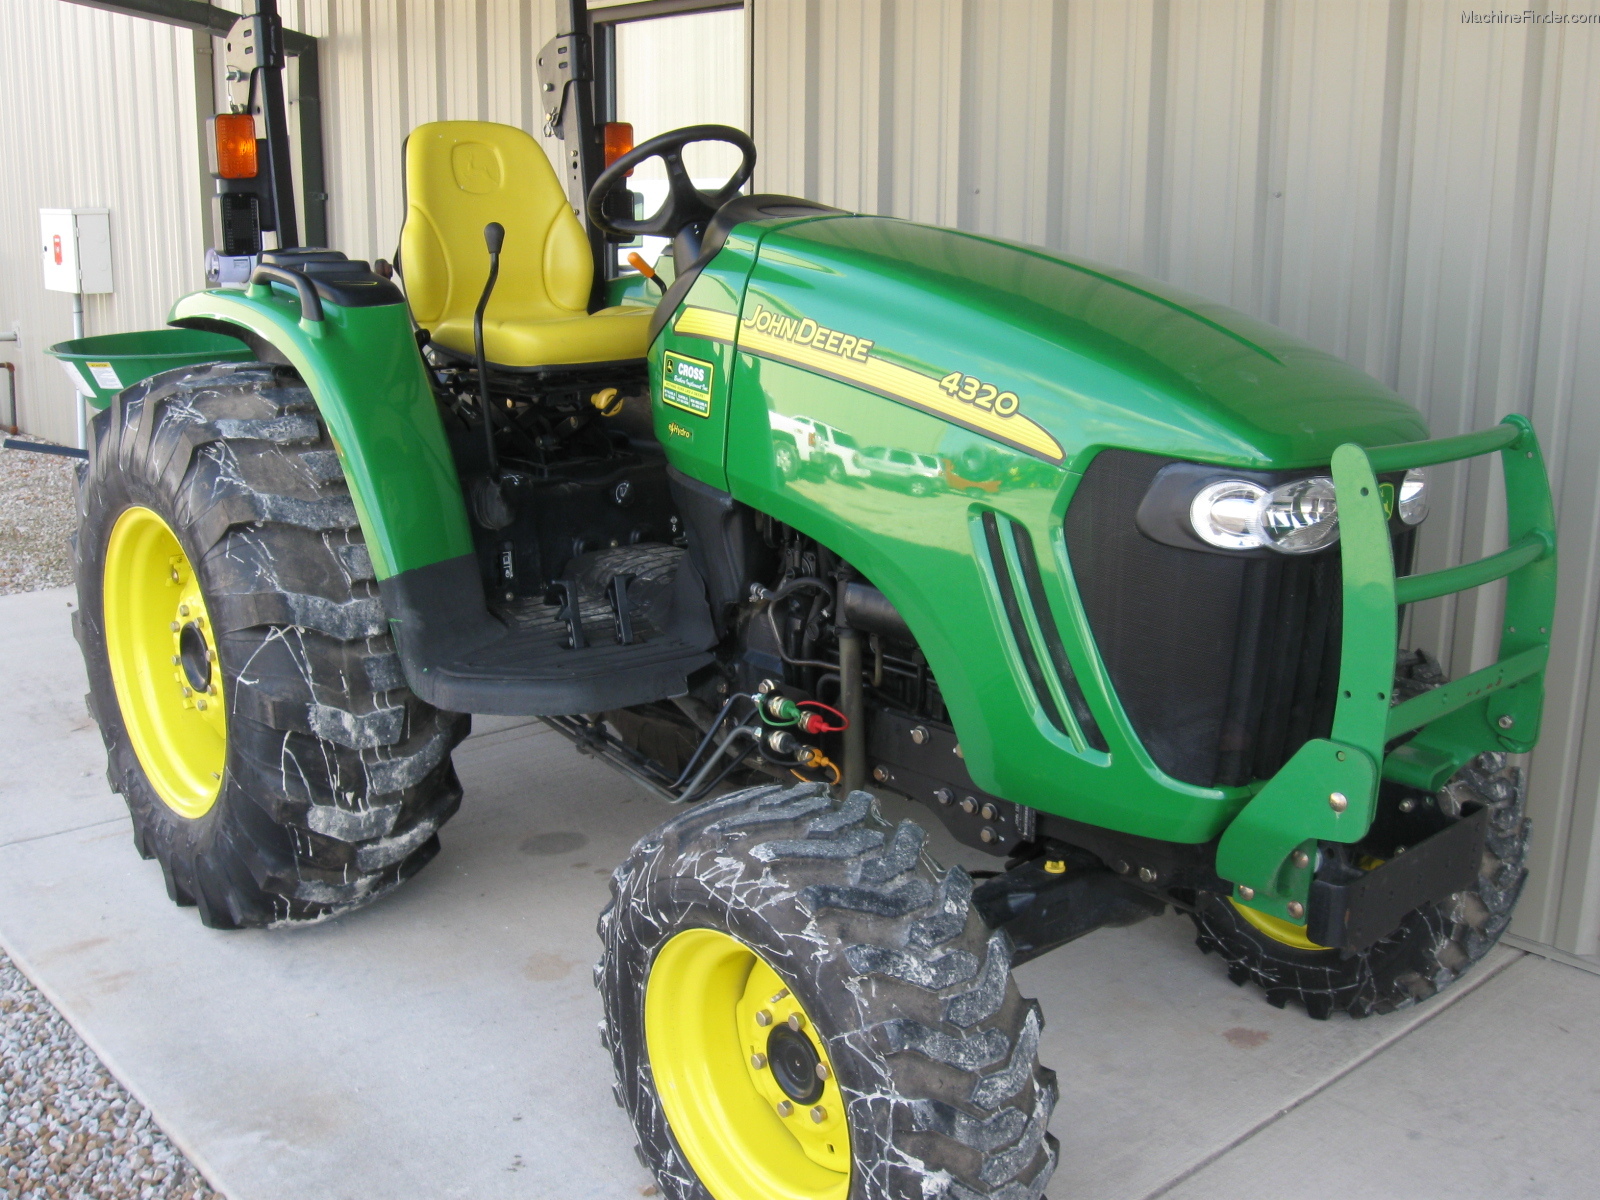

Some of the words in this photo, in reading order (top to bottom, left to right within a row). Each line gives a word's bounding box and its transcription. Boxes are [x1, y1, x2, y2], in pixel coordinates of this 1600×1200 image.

[743, 304, 799, 341] JOHN
[794, 317, 875, 363] DEERE
[678, 362, 704, 382] CROSS
[939, 370, 1019, 418] 4320
